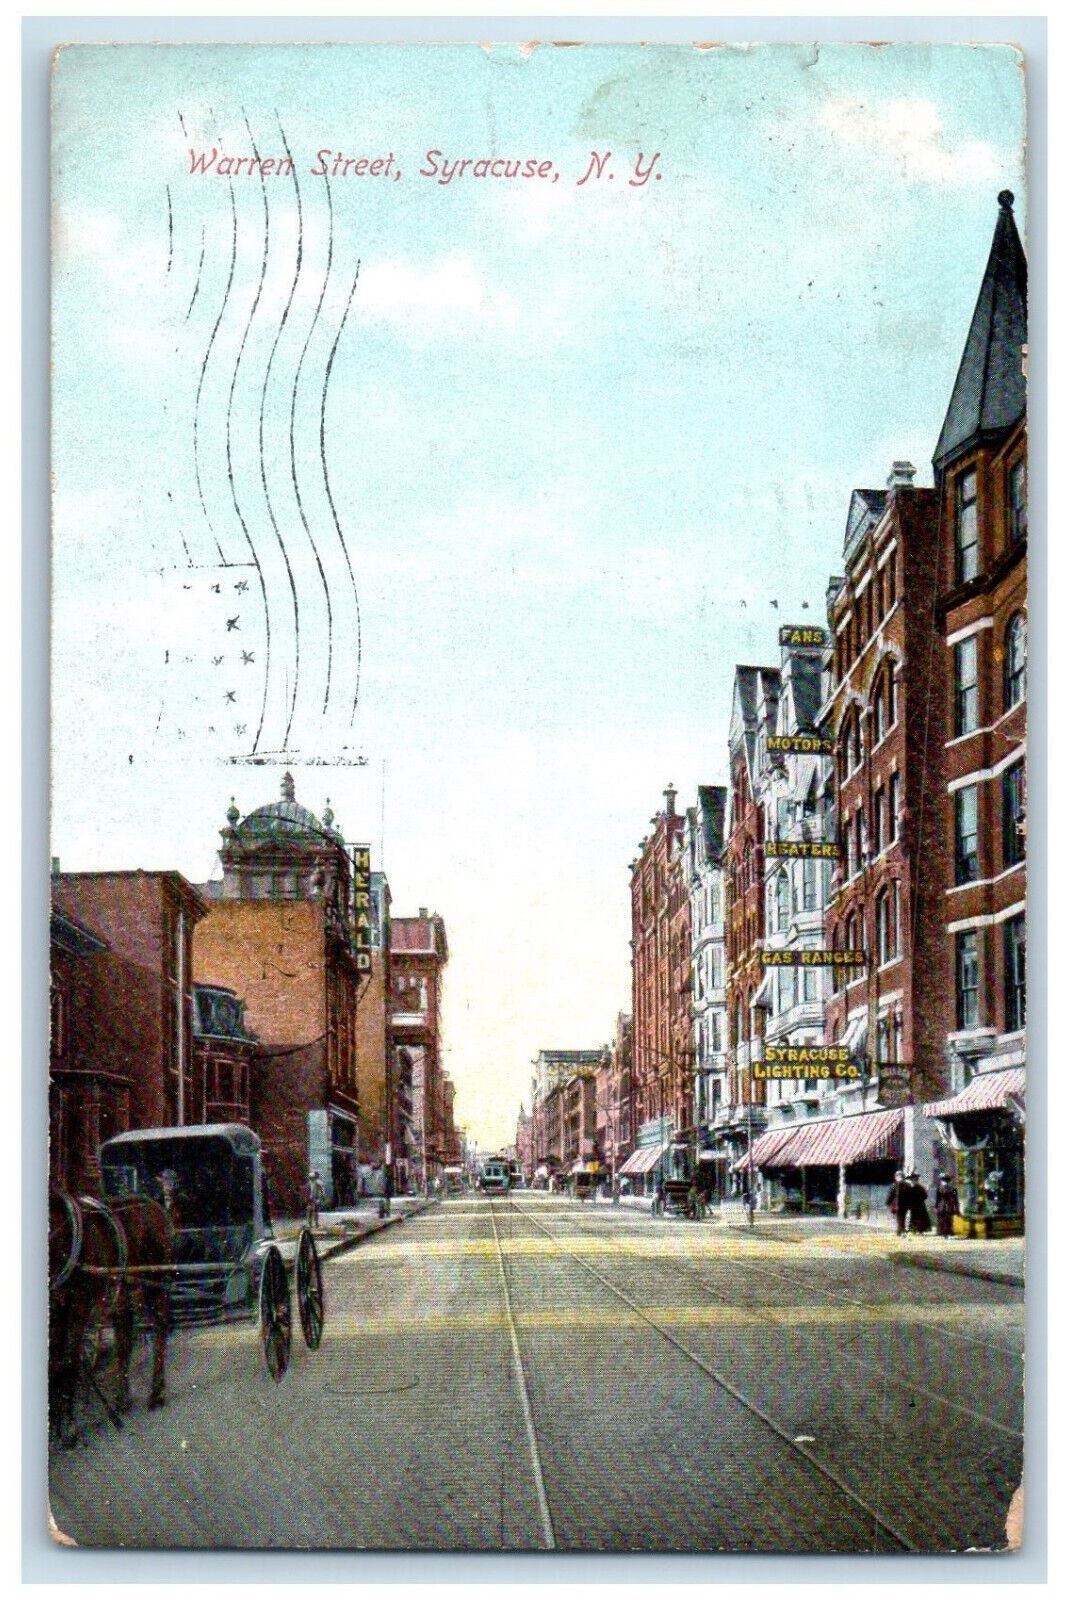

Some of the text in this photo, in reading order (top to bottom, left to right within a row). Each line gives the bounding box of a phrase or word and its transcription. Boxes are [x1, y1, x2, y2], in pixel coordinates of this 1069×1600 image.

[782, 629, 822, 643] FANS
[767, 737, 832, 751] MOTORS
[767, 843, 841, 856] HEATERS
[355, 850, 370, 969] HERALD
[761, 951, 864, 964] GAS RANGES
[765, 1046, 849, 1061] SYRACUSE
[754, 1063, 830, 1078] LIGHTING
